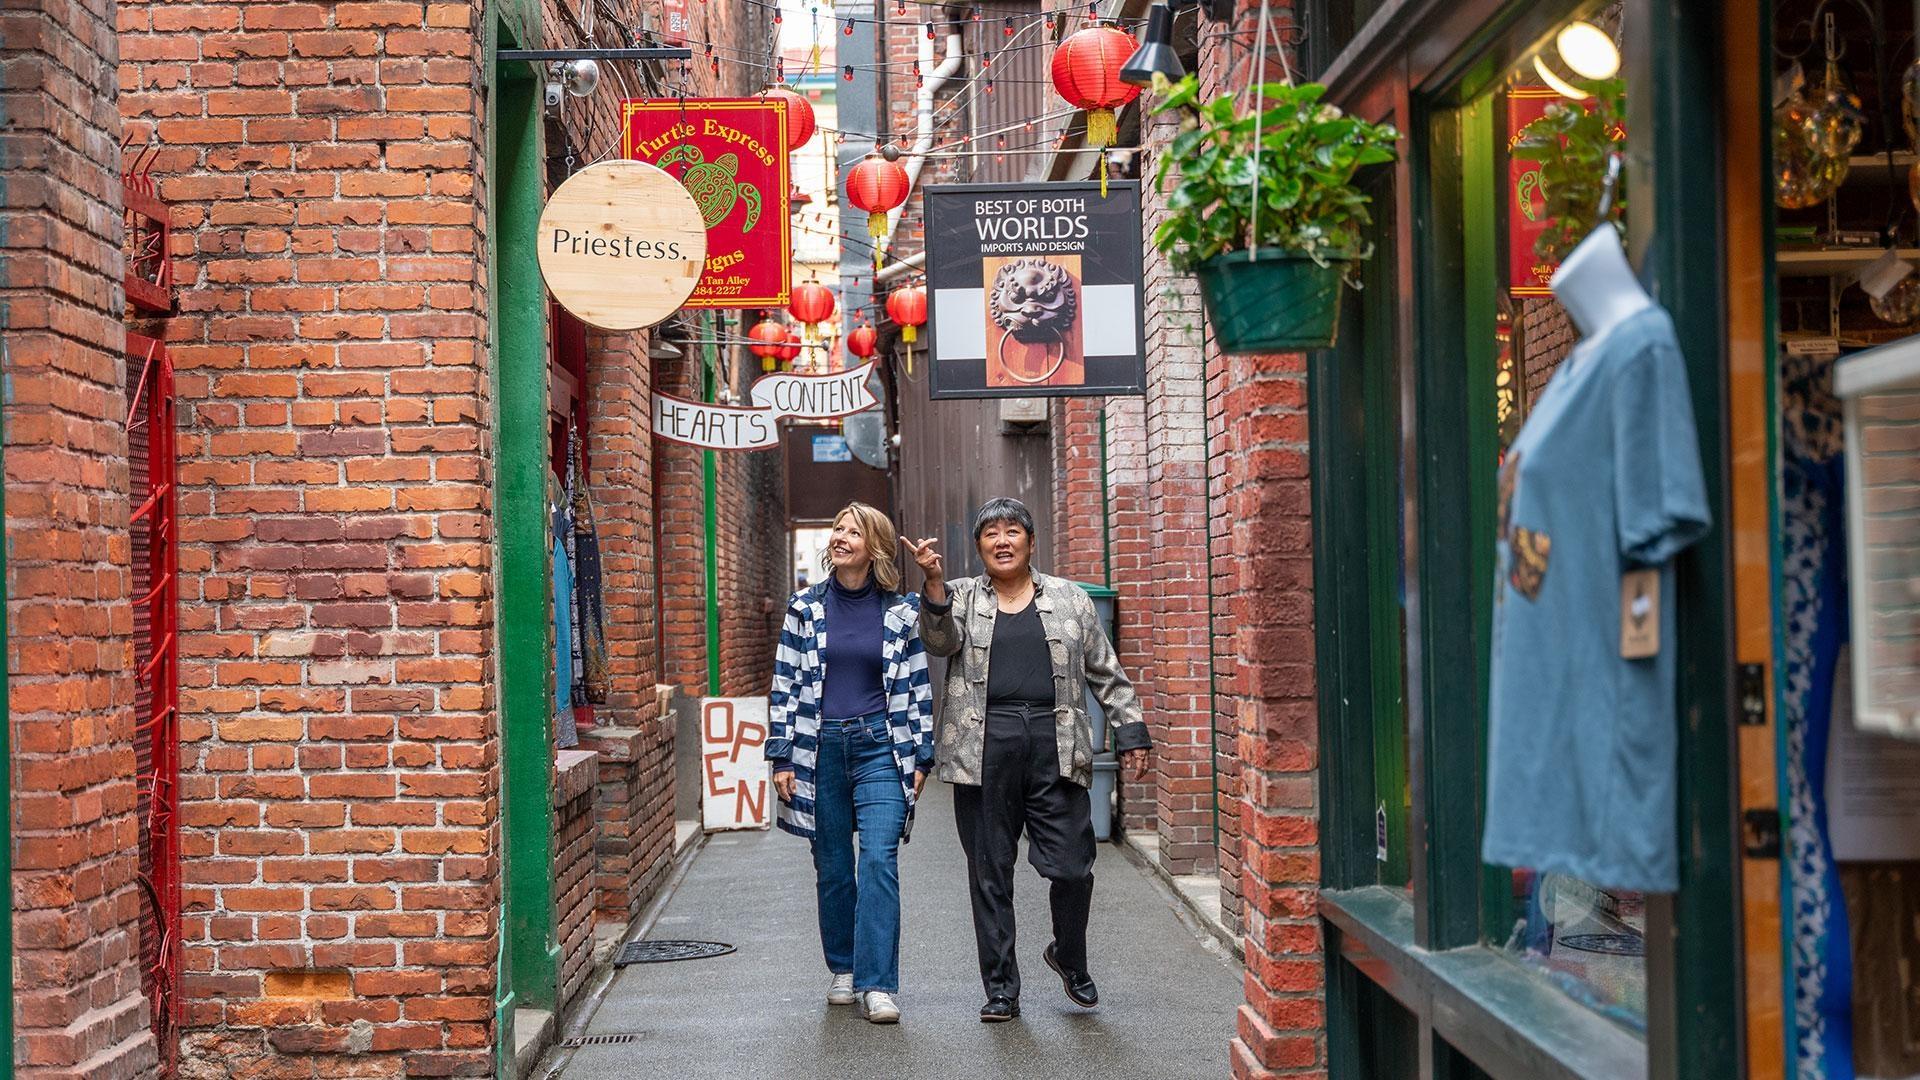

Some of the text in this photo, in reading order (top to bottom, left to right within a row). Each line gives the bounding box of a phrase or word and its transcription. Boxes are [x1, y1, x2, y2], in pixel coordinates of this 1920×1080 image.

[635, 118, 776, 167] Turtle Express
[975, 198, 1085, 215] BEST OF BOTH
[975, 215, 1089, 240] WORLDS
[553, 228, 687, 260] Priestess.
[981, 241, 1085, 252] IMPORTS AND DESIGN
[705, 249, 745, 273] igns
[693, 285, 742, 295] 384-2227
[705, 276, 724, 285] Tan
[726, 275, 751, 287] Alley
[774, 374, 864, 413] CONTENT
